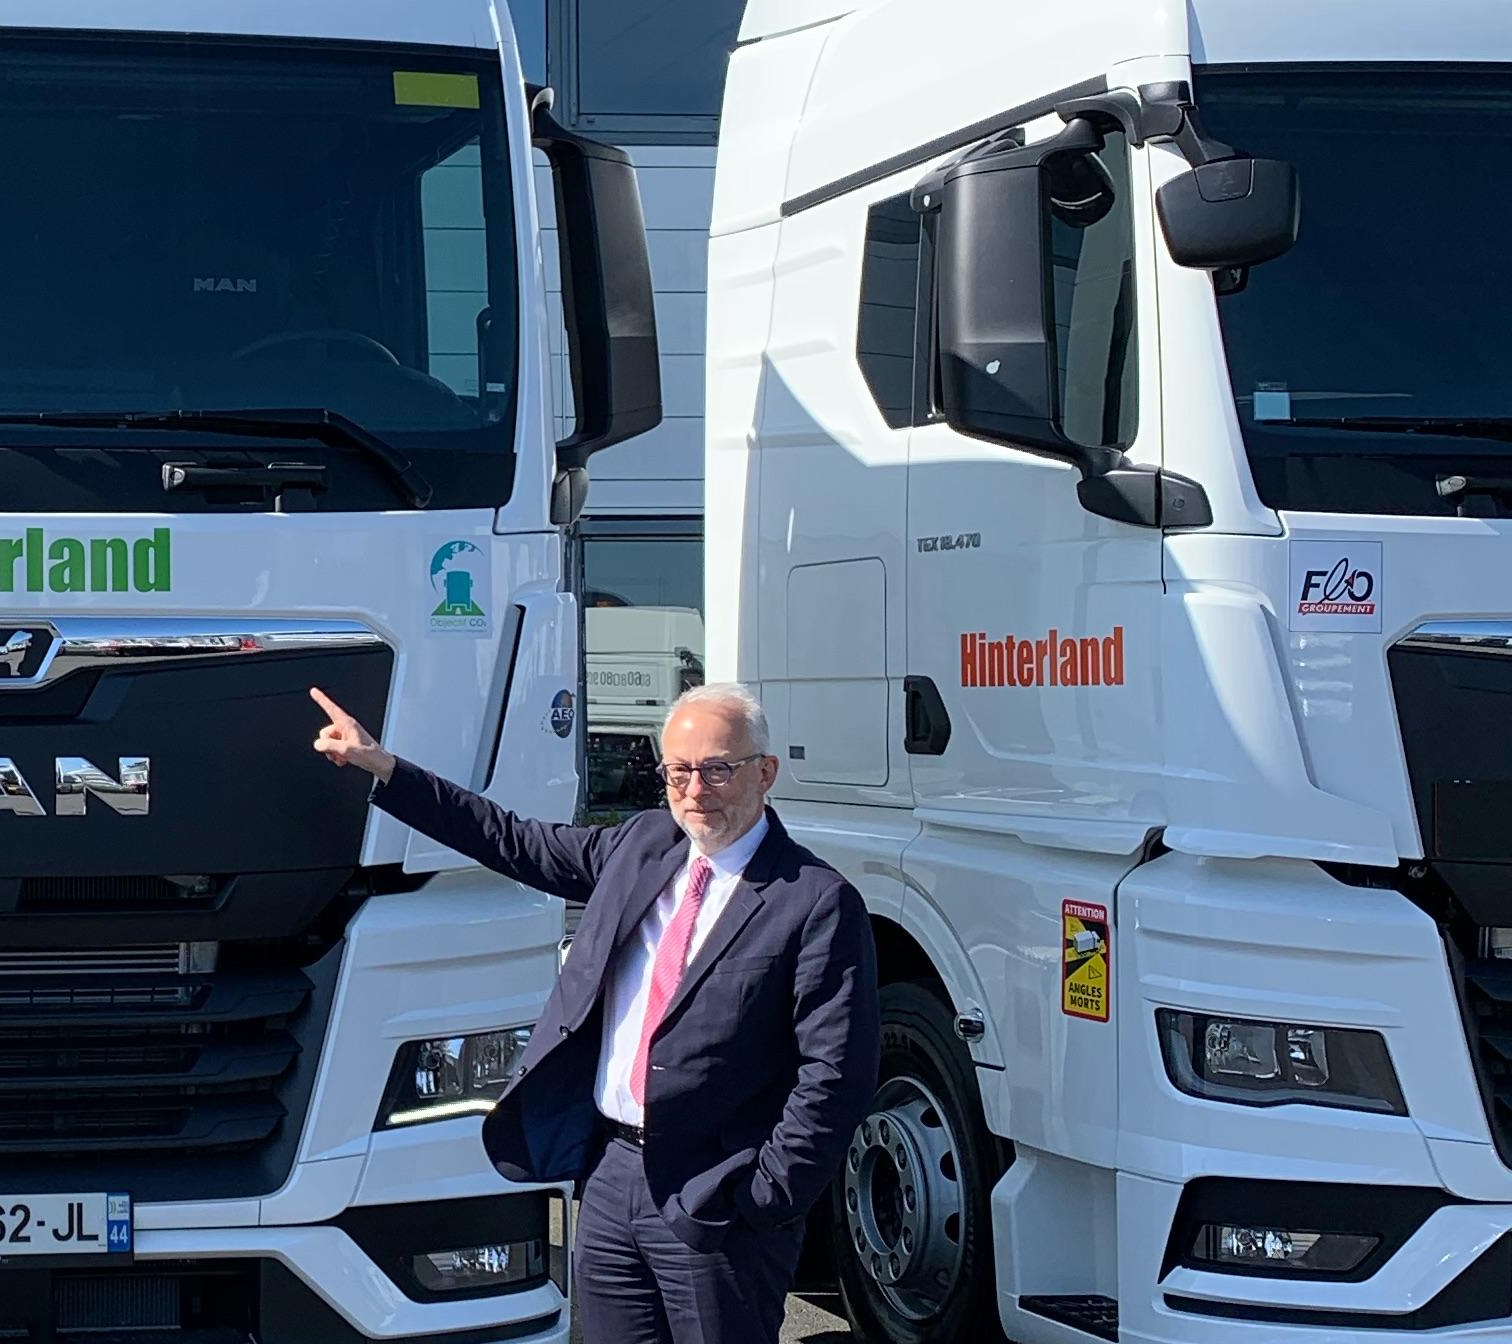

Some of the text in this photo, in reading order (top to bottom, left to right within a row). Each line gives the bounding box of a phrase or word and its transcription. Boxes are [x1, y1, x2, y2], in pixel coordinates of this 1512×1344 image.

[193, 277, 257, 293] MAN
[1301, 604, 1372, 613] GROUPEMENT
[960, 626, 1124, 687] Hinterland
[551, 708, 575, 720] AEO
[1065, 903, 1105, 919] ATTENTION
[1068, 981, 1103, 998] ANGLES
[1069, 994, 1101, 1011] MORTS
[109, 1224, 129, 1244] 44
